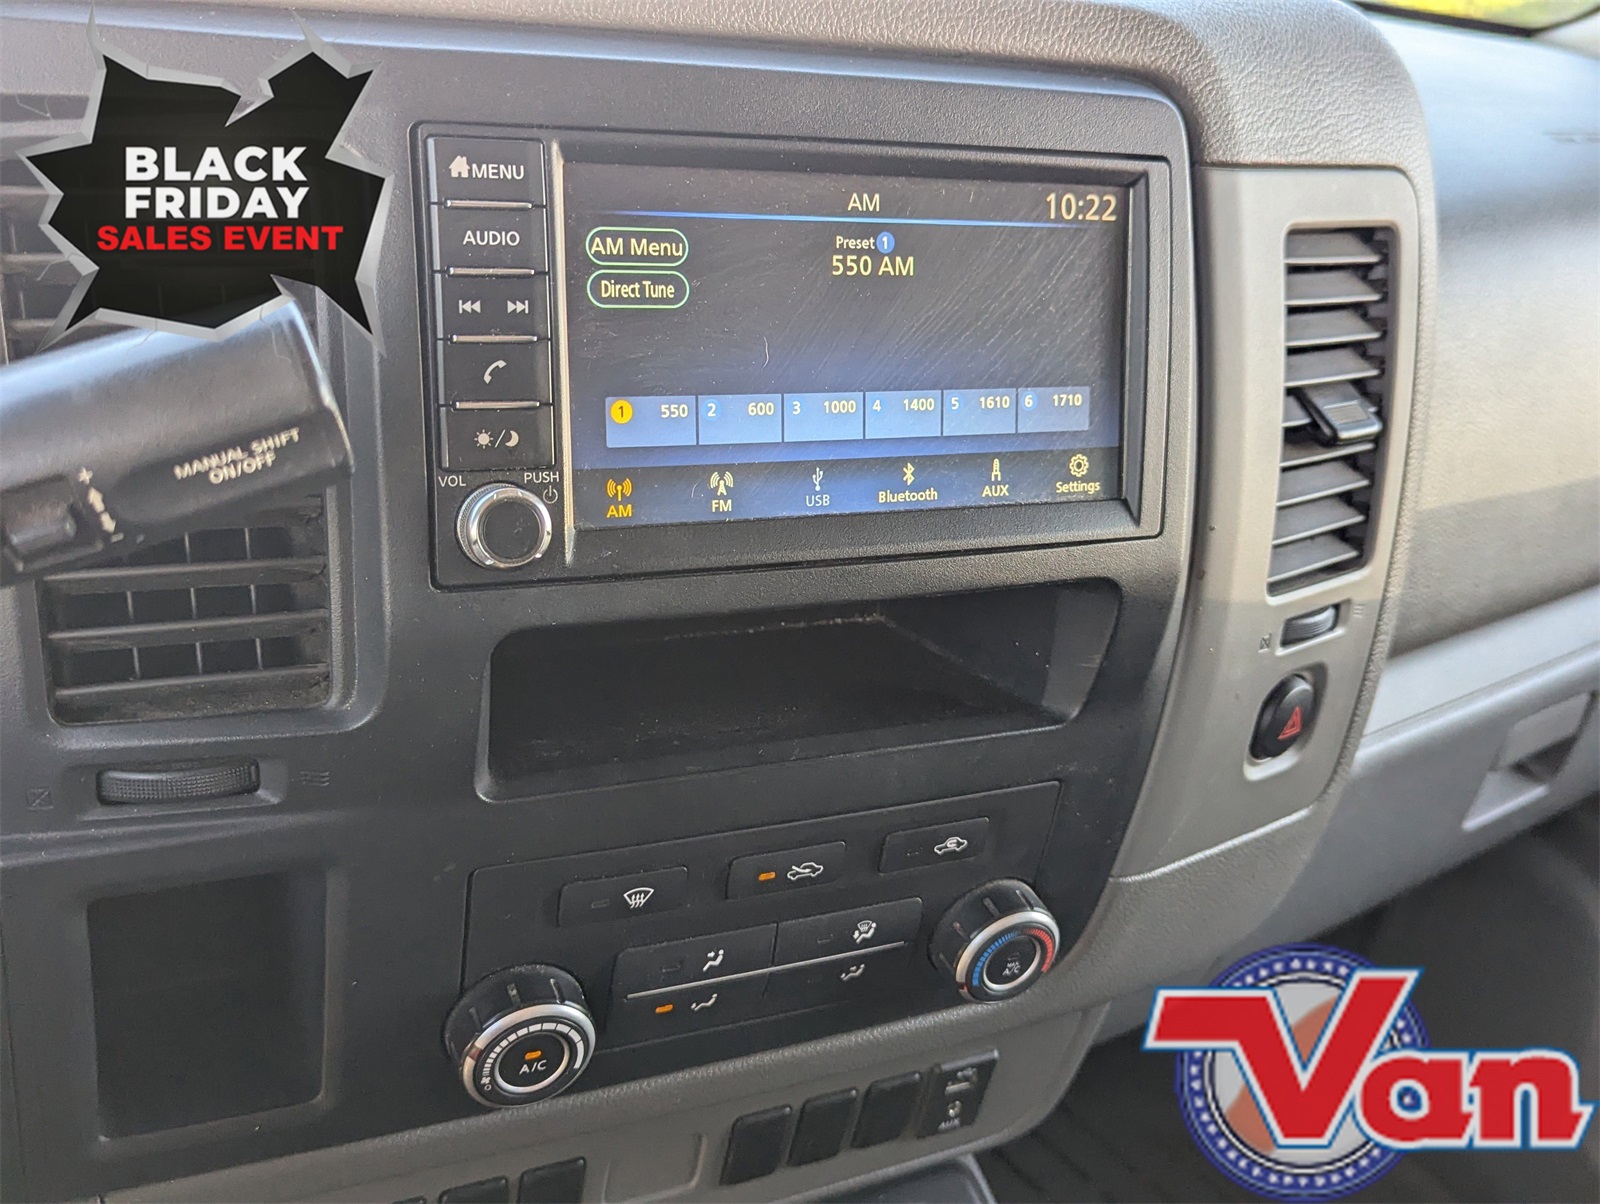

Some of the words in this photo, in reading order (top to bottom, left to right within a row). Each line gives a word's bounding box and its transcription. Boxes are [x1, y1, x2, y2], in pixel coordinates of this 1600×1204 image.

[472, 163, 525, 180] MENU
[847, 193, 880, 212] AM
[1046, 192, 1117, 221] 10:22
[463, 230, 520, 246] AUDIO
[835, 235, 875, 250] Preset
[590, 237, 623, 255] AM
[630, 238, 683, 256] Menu
[831, 255, 872, 276] 550
[878, 256, 914, 276] AM
[601, 280, 640, 298] Direct
[642, 281, 675, 298] Tune
[792, 400, 801, 415] 3
[823, 400, 856, 414] 1000
[872, 399, 882, 413] 4
[903, 398, 935, 411] 1400
[951, 396, 959, 411] 5
[979, 395, 1010, 409] 1610
[1024, 394, 1033, 408] 6
[1053, 393, 1083, 407] 1710
[660, 404, 689, 419] 550
[707, 402, 716, 417] 2
[747, 401, 775, 416] 600
[173, 446, 248, 480] MANUAL
[251, 427, 300, 455] SHIFT
[208, 449, 276, 485] ON/OFF
[438, 475, 467, 488] VOL
[523, 471, 560, 484] PUSH
[982, 484, 1009, 498] AUX
[1055, 479, 1100, 495] Settings
[805, 494, 830, 507] USB
[878, 487, 938, 504] Bluetooth
[606, 503, 632, 518] AM
[711, 499, 733, 512] FM
[1002, 964, 1021, 976] A/C
[519, 1059, 547, 1076] A/C
